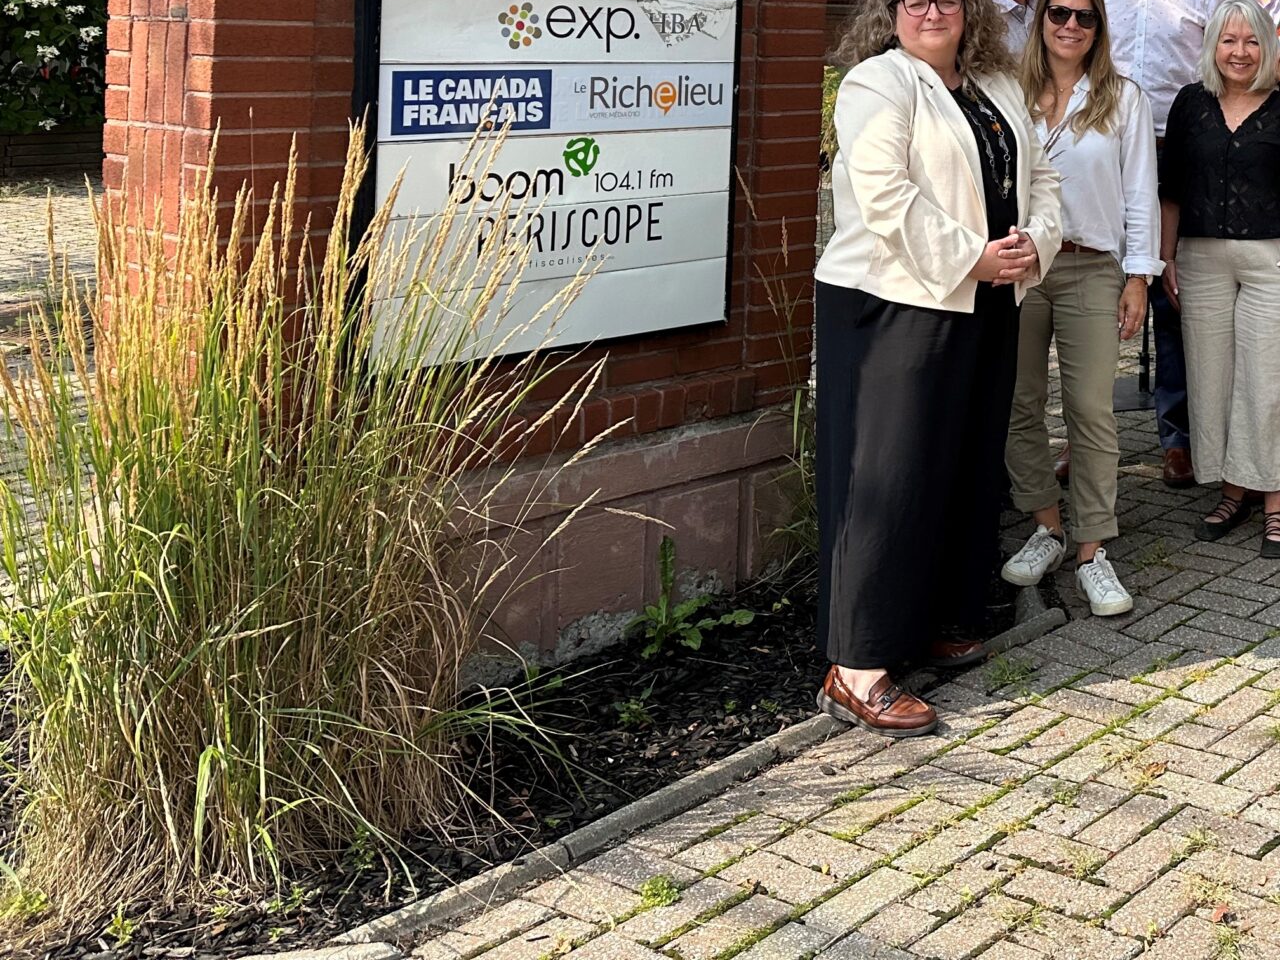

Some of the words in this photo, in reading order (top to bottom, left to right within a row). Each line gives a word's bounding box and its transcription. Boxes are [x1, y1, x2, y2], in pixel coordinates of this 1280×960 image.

[545, 5, 641, 53] exp.
[403, 79, 434, 101] LE
[438, 78, 543, 101] CANADA
[574, 81, 587, 94] Le
[589, 75, 724, 110] Richelieu
[448, 163, 564, 205] boom
[594, 171, 642, 191] 104.1
[650, 169, 673, 188] fm
[528, 254, 605, 268] fiscalises
